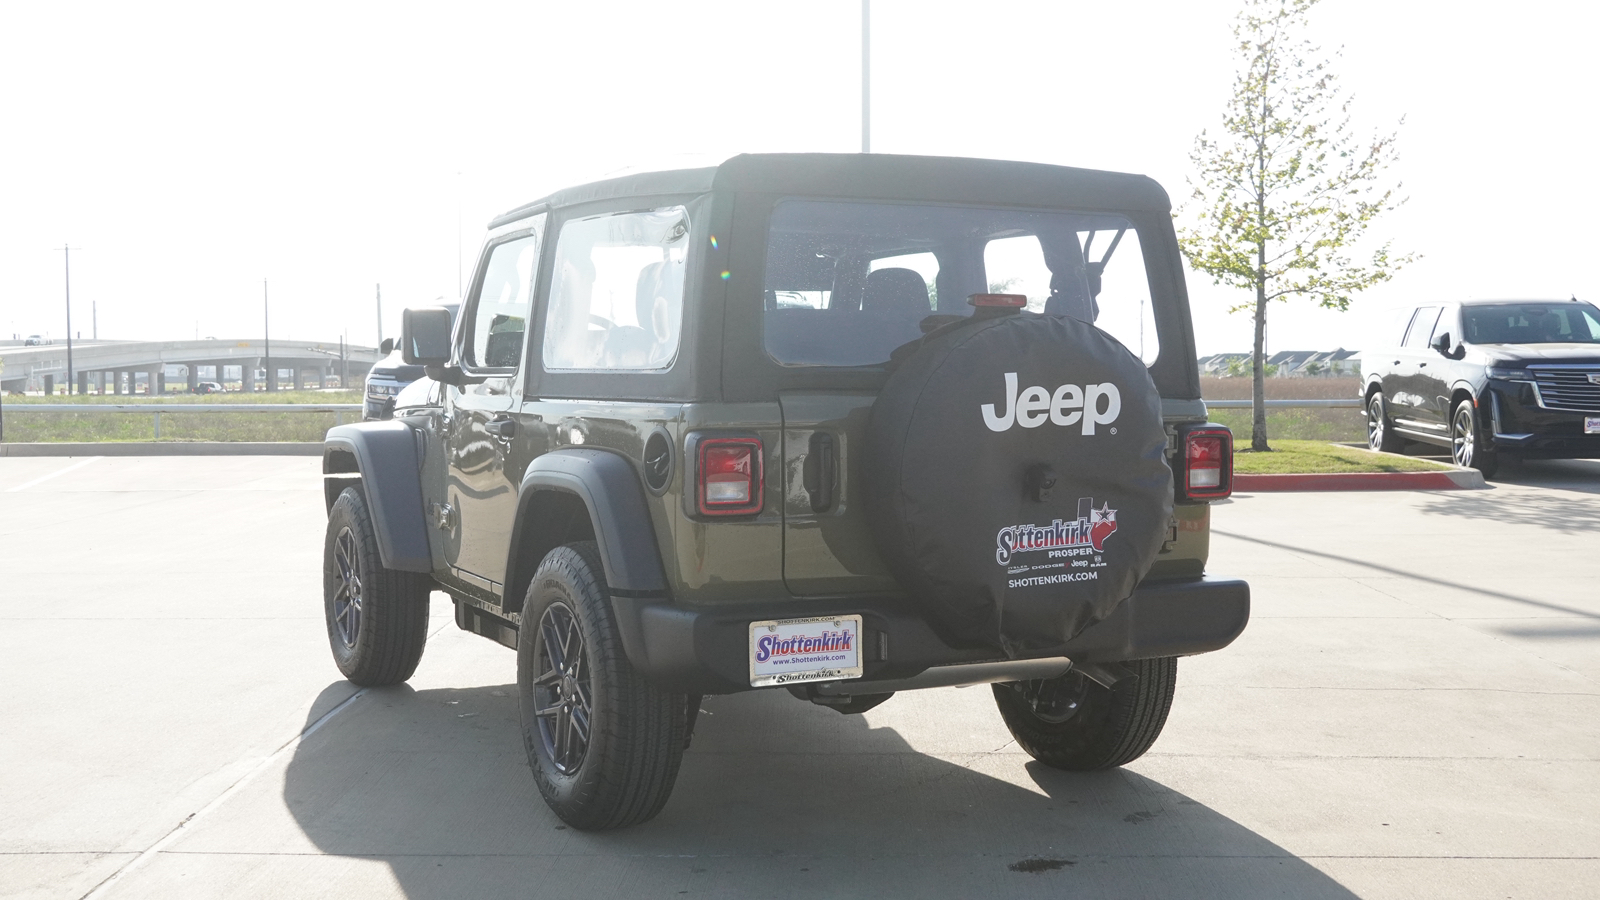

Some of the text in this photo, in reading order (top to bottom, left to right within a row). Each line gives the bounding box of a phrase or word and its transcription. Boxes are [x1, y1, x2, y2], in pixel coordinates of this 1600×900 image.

[981, 372, 1121, 435] Jeep
[1048, 548, 1093, 558] PROSPER
[1071, 559, 1088, 568] Jeep
[1008, 571, 1098, 588] SHOTTENKIRK.COM
[756, 630, 854, 662] Shottenkirk
[772, 655, 846, 665] www.Shottenkirk.com
[776, 666, 835, 683] Shottenkirk
